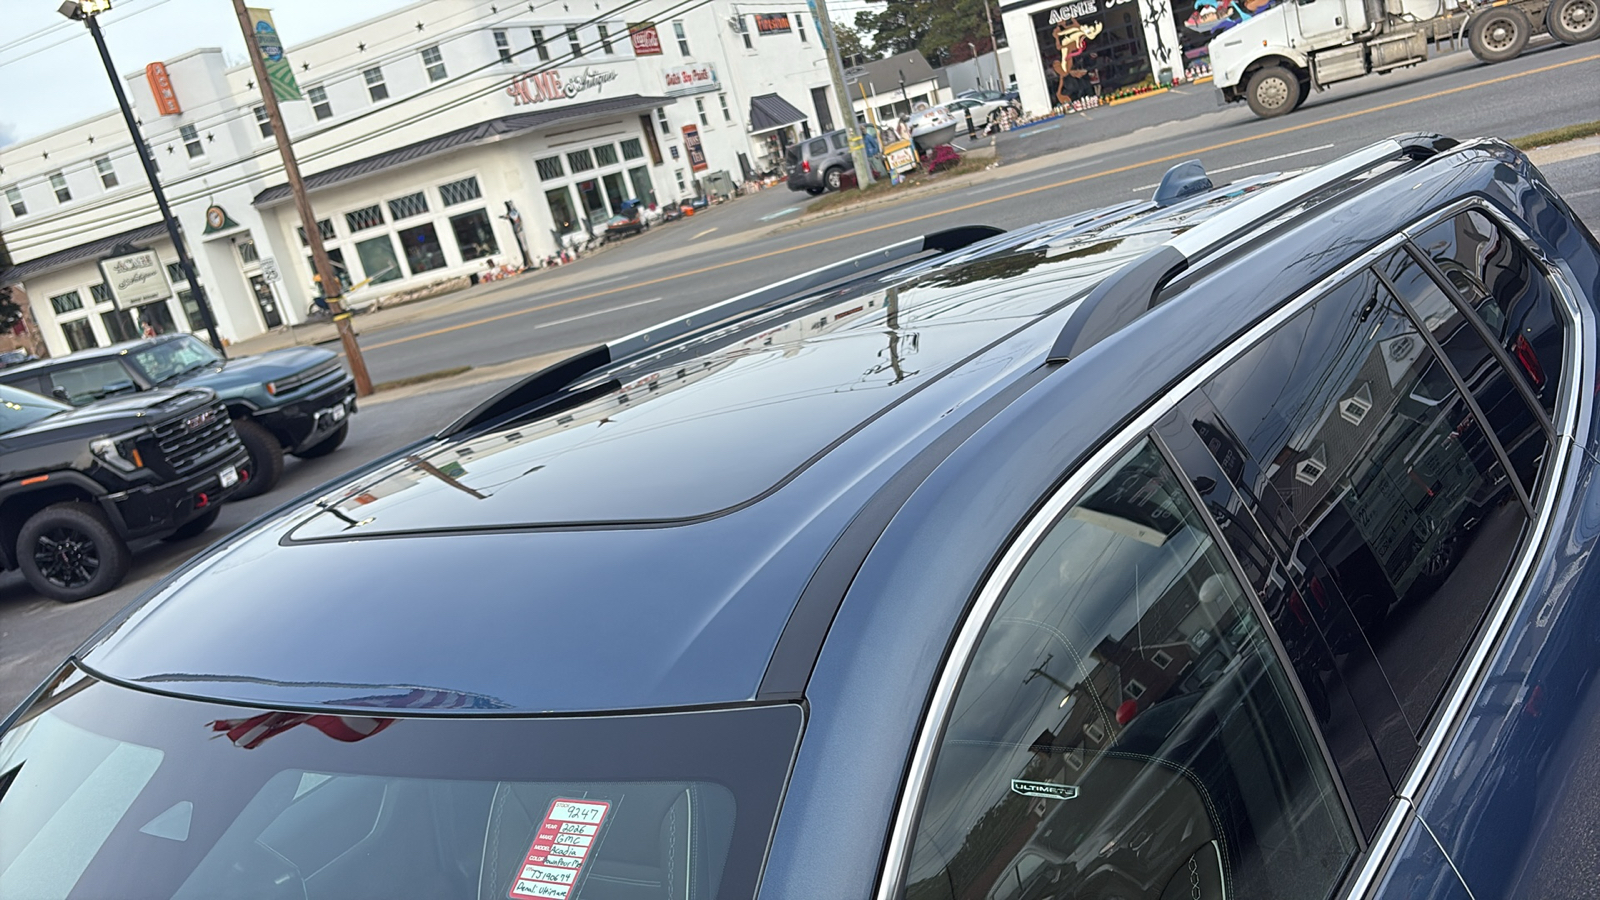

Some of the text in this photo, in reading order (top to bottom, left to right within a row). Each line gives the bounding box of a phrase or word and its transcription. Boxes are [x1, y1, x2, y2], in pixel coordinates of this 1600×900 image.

[1048, 0, 1098, 24] ACME
[507, 70, 566, 106] ACME
[567, 805, 599, 820] 9247
[562, 823, 586, 834] 2026
[556, 834, 581, 844] GMC
[550, 846, 577, 856] Acadia
